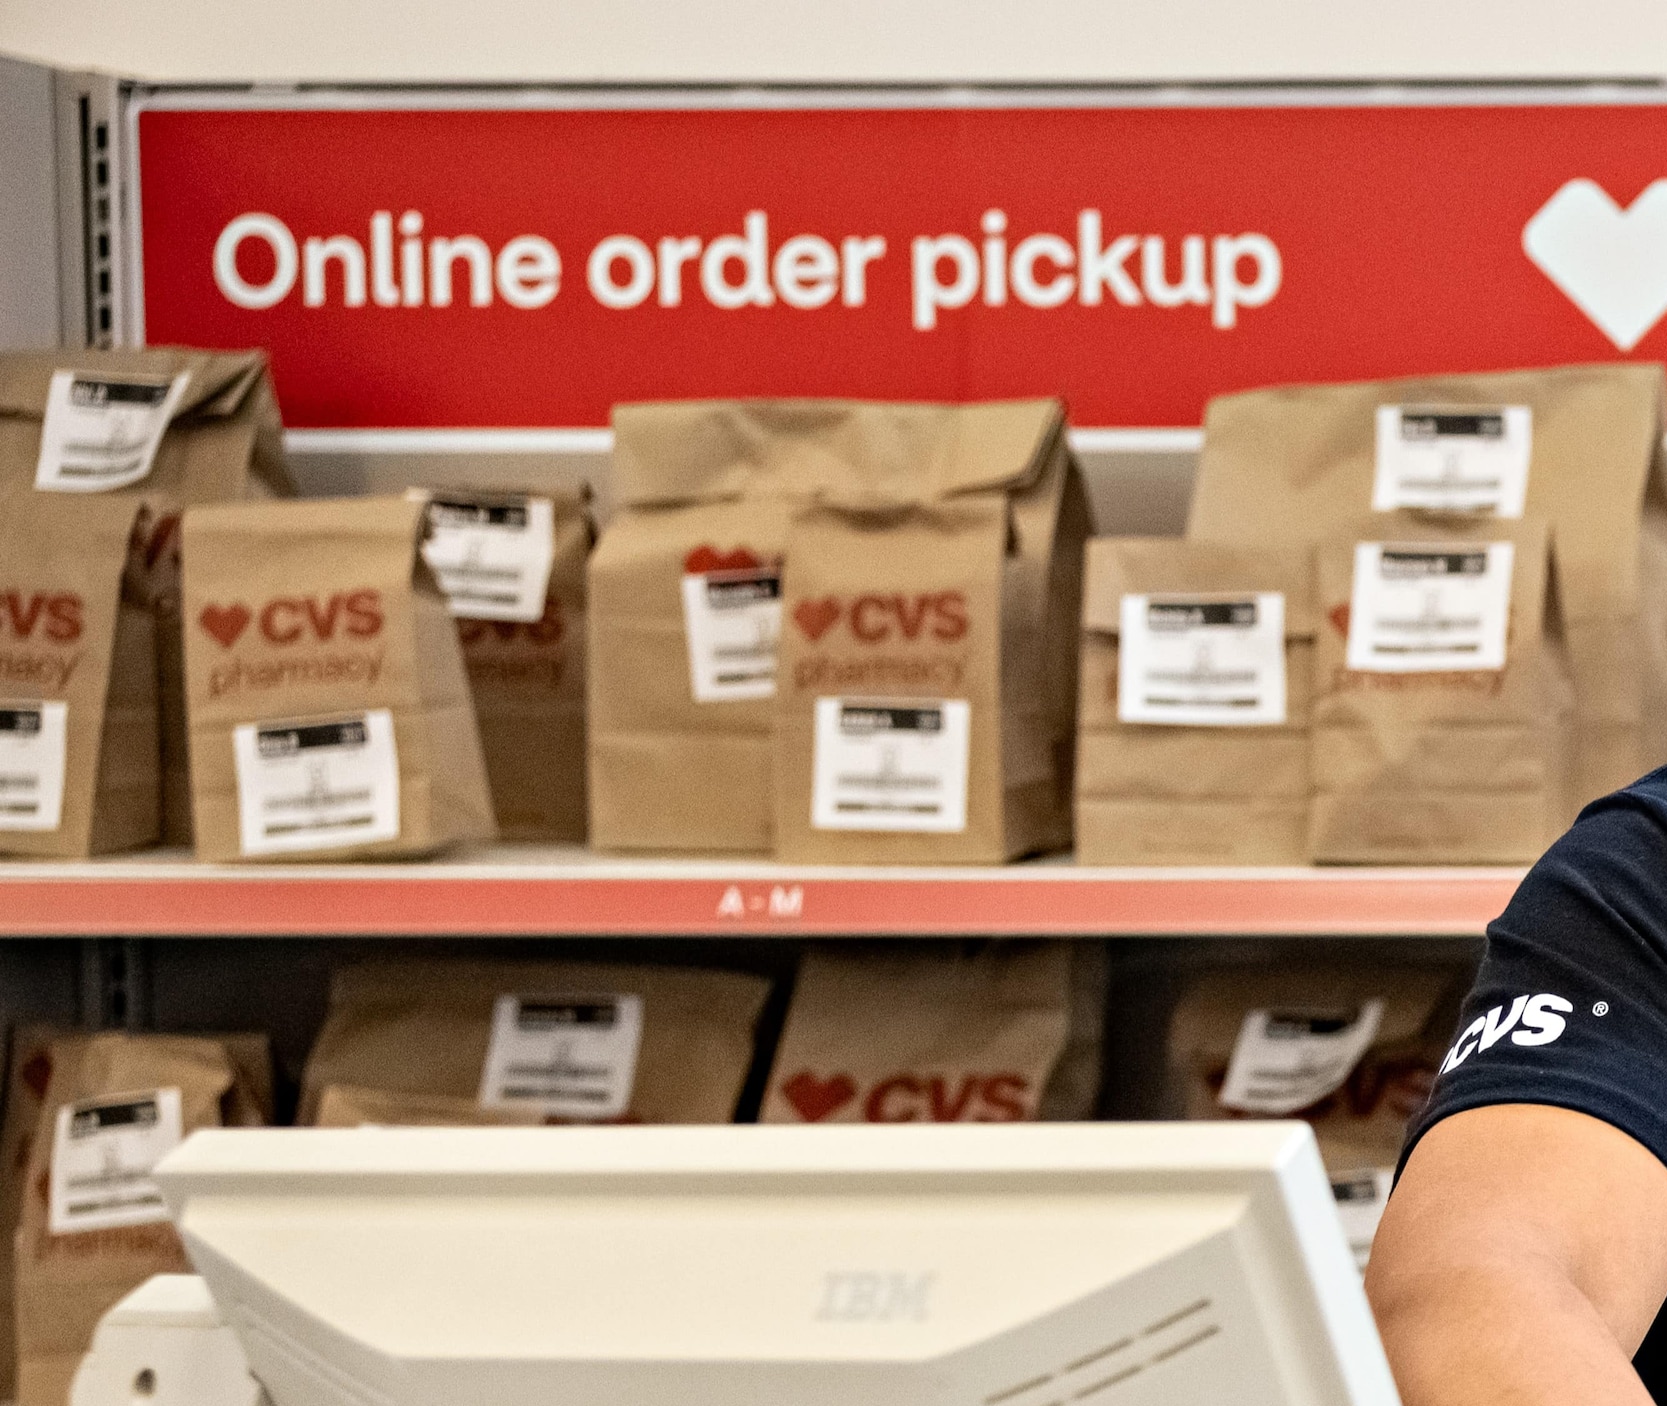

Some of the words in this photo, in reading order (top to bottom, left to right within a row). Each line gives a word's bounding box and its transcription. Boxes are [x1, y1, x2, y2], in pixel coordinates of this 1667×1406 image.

[212, 209, 562, 311] Online
[587, 209, 886, 311] order
[910, 208, 1284, 331] pickup
[258, 588, 385, 643] CVS
[849, 590, 969, 643] CVS
[1441, 992, 1574, 1076] CVS
[813, 1269, 939, 1323] IBM
